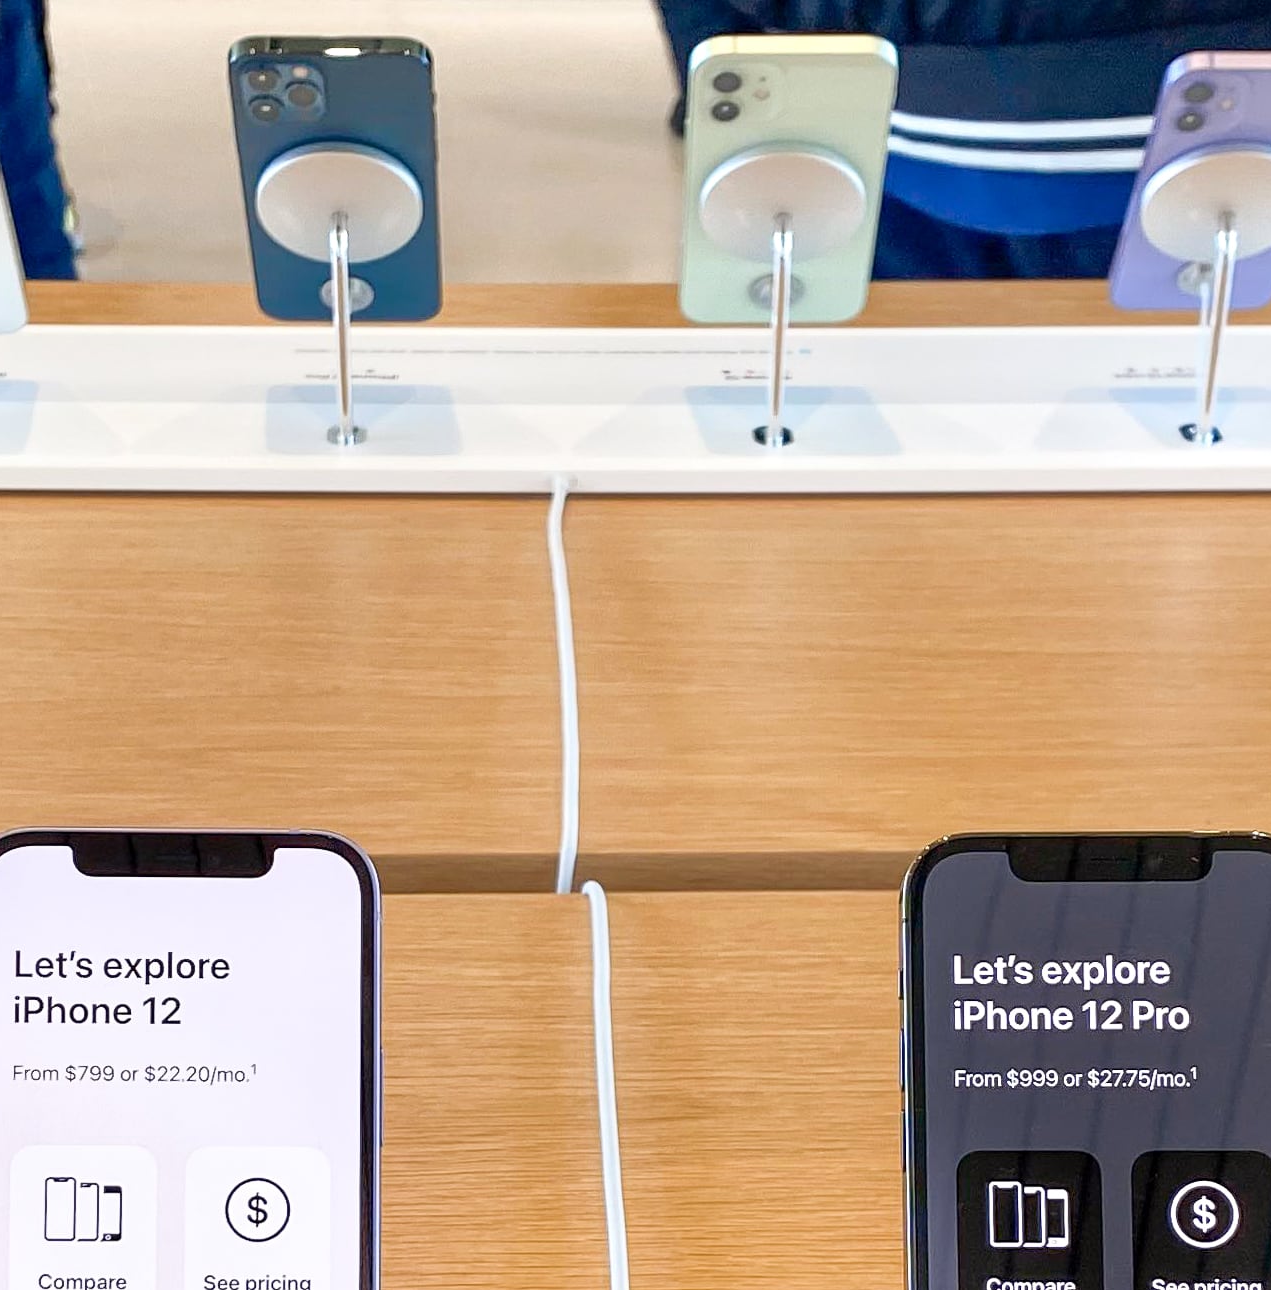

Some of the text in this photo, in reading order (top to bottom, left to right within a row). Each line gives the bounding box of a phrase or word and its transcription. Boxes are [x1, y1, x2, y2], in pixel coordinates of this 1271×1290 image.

[16, 951, 229, 985] Let's explore
[954, 955, 1170, 990] Let's explore
[15, 996, 180, 1024] iPhone 12
[954, 1000, 1189, 1030] iPhone 12 Pro
[14, 1066, 58, 1080] From
[66, 1065, 114, 1082] $799
[121, 1070, 137, 1081] or
[955, 1070, 1002, 1087] From
[1007, 1069, 1058, 1088] $999
[1064, 1074, 1083, 1086] or
[204, 1275, 239, 1290] See
